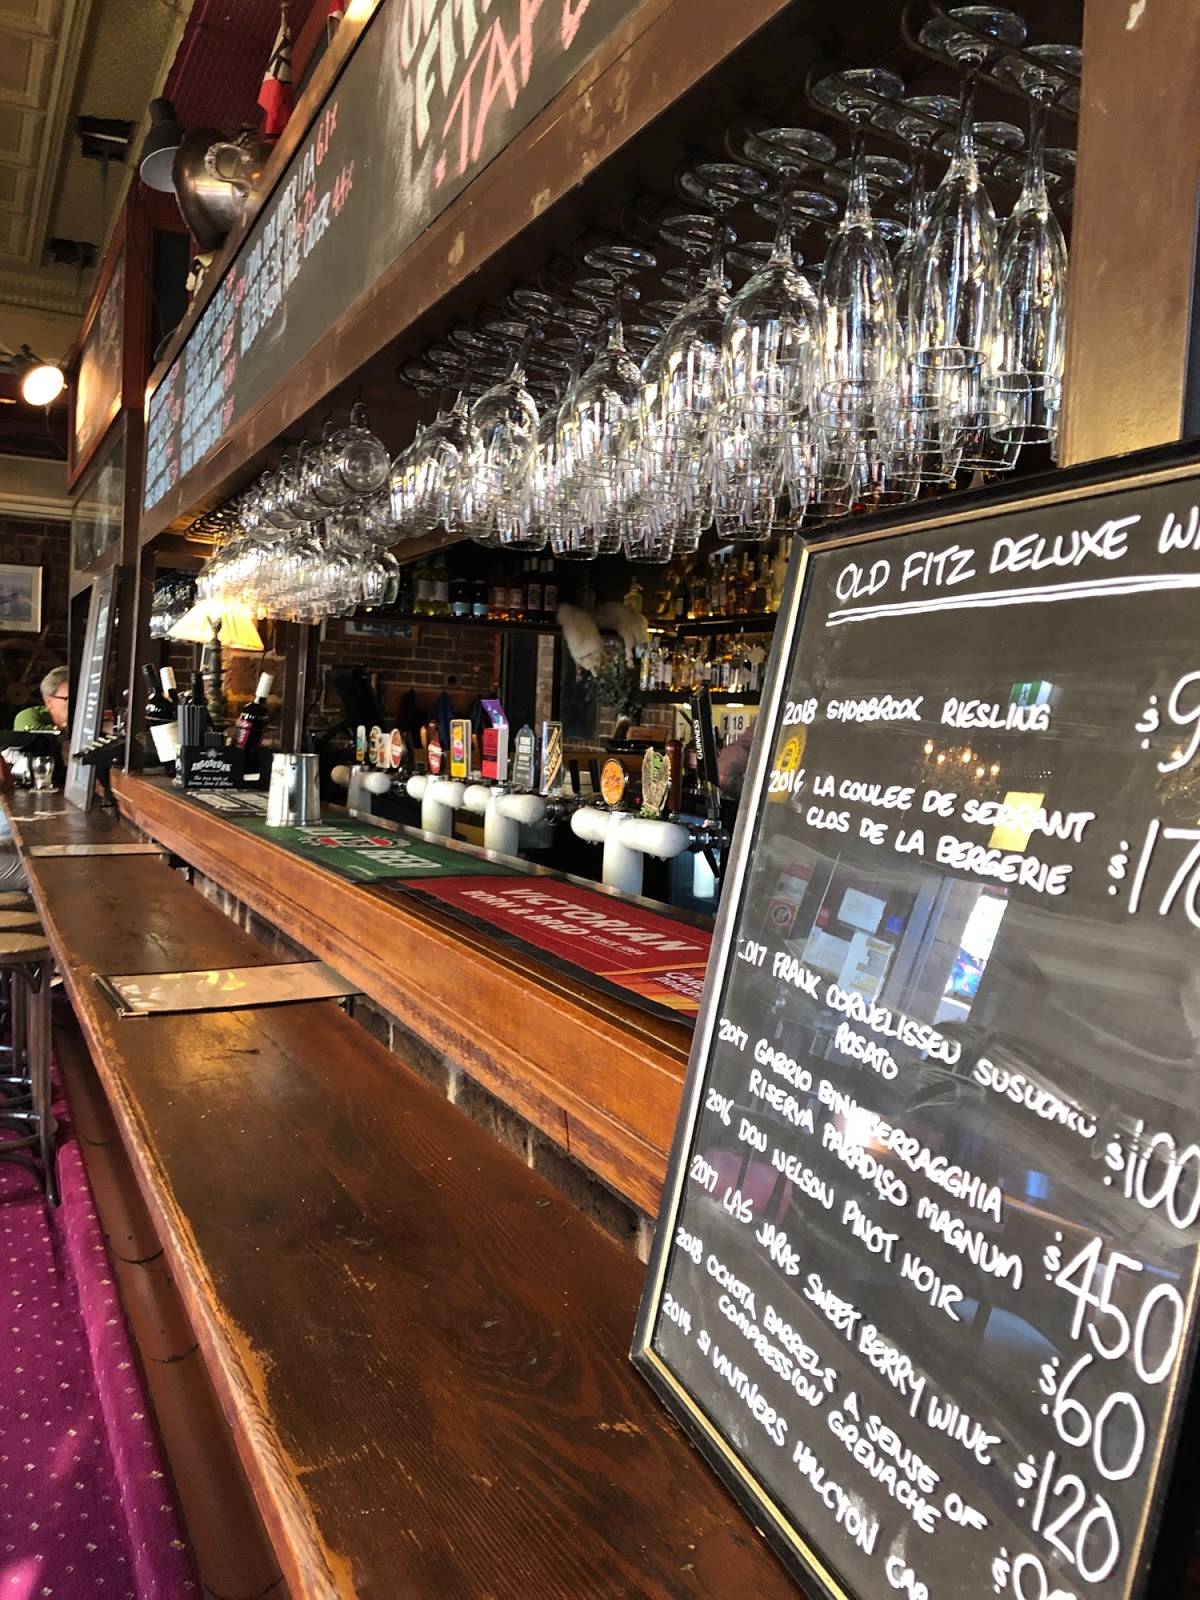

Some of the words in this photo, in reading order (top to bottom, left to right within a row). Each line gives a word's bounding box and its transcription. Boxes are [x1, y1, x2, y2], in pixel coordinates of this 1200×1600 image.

[836, 560, 890, 601] OLD
[902, 545, 977, 592] FITZ
[989, 515, 1141, 575] DELUXE
[692, 719, 704, 760] GUINNESS
[782, 697, 819, 726] 2018
[940, 697, 1051, 731] RIESLING
[813, 775, 836, 798] LA
[838, 780, 916, 812] COULEE
[922, 790, 958, 818] DE
[806, 806, 851, 833] CLOS
[859, 817, 889, 846] DE
[895, 829, 925, 856] LA
[935, 835, 1074, 896] BERGERIE
[460, 889, 521, 910] BORN
[524, 913, 591, 936] BRED
[500, 887, 704, 952] VICTORIAN
[772, 951, 822, 1000] FRANK
[825, 983, 963, 1066] CORNELISSEN
[834, 1021, 899, 1081] ROSATO
[718, 1017, 749, 1051] 2017
[754, 1038, 813, 1093] GABRIO
[705, 1087, 735, 1128] 2016
[738, 1117, 769, 1154] DON
[772, 1148, 834, 1211] NELSON
[842, 1199, 899, 1263] PINOT
[900, 1252, 963, 1322] NOIR
[748, 1068, 814, 1134] RISERVA
[917, 1196, 1023, 1290] MAGNUM
[689, 1154, 719, 1194] 2017
[723, 1186, 754, 1225] LAS
[755, 1222, 801, 1276] JARAS
[803, 1273, 862, 1341] SWEET
[858, 1324, 926, 1418] BERRY
[927, 1395, 1002, 1466] WINE
[675, 1226, 704, 1266] 2018
[706, 1254, 758, 1321] OCHOTA
[763, 1304, 838, 1394] BARRELS
[842, 1391, 860, 1422] A
[865, 1414, 941, 1493] SENSE
[944, 1492, 989, 1531] OF
[718, 1294, 825, 1408] COMPRESSION
[827, 1410, 942, 1535] GRENACHE
[662, 1292, 692, 1336] 2014
[712, 1345, 789, 1448] VINTNERS
[793, 1440, 879, 1556] HALCYON
